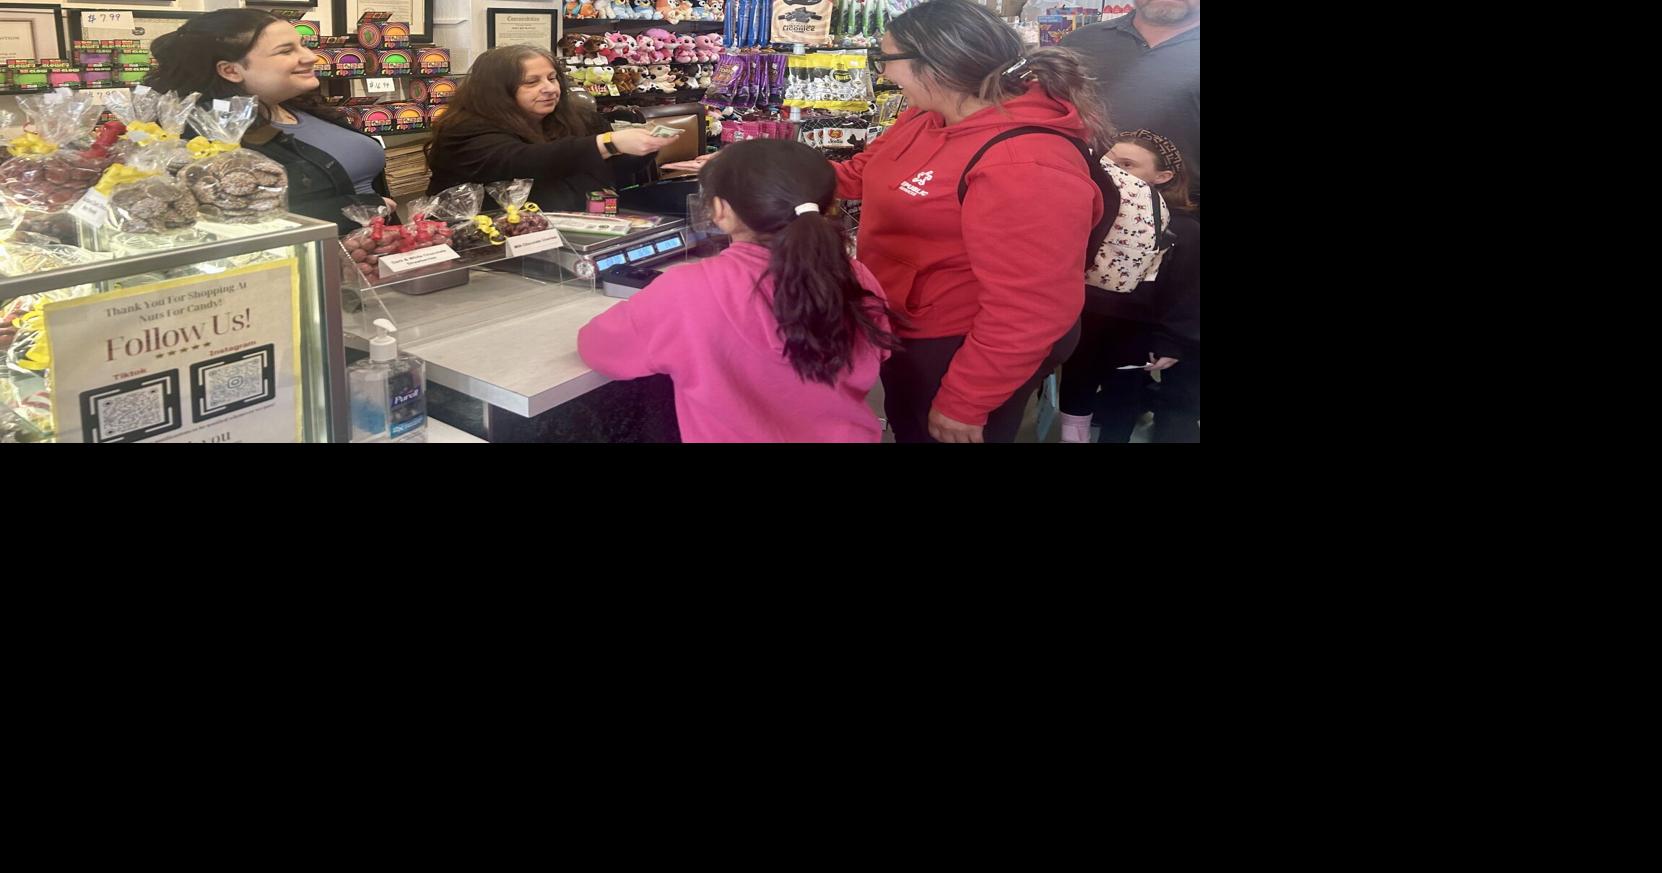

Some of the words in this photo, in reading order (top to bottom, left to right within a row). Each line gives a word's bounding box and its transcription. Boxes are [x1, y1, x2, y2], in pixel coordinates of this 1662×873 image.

[106, 303, 142, 317] Thank
[143, 297, 165, 309] You
[167, 294, 186, 304] For
[187, 285, 235, 300] Shopping
[235, 282, 247, 290] At
[138, 312, 164, 322] Nuts
[166, 308, 185, 318] For
[186, 299, 223, 313] Candy!
[106, 322, 207, 362] Follow
[211, 307, 251, 335] Us!
[209, 340, 257, 356] Instagram
